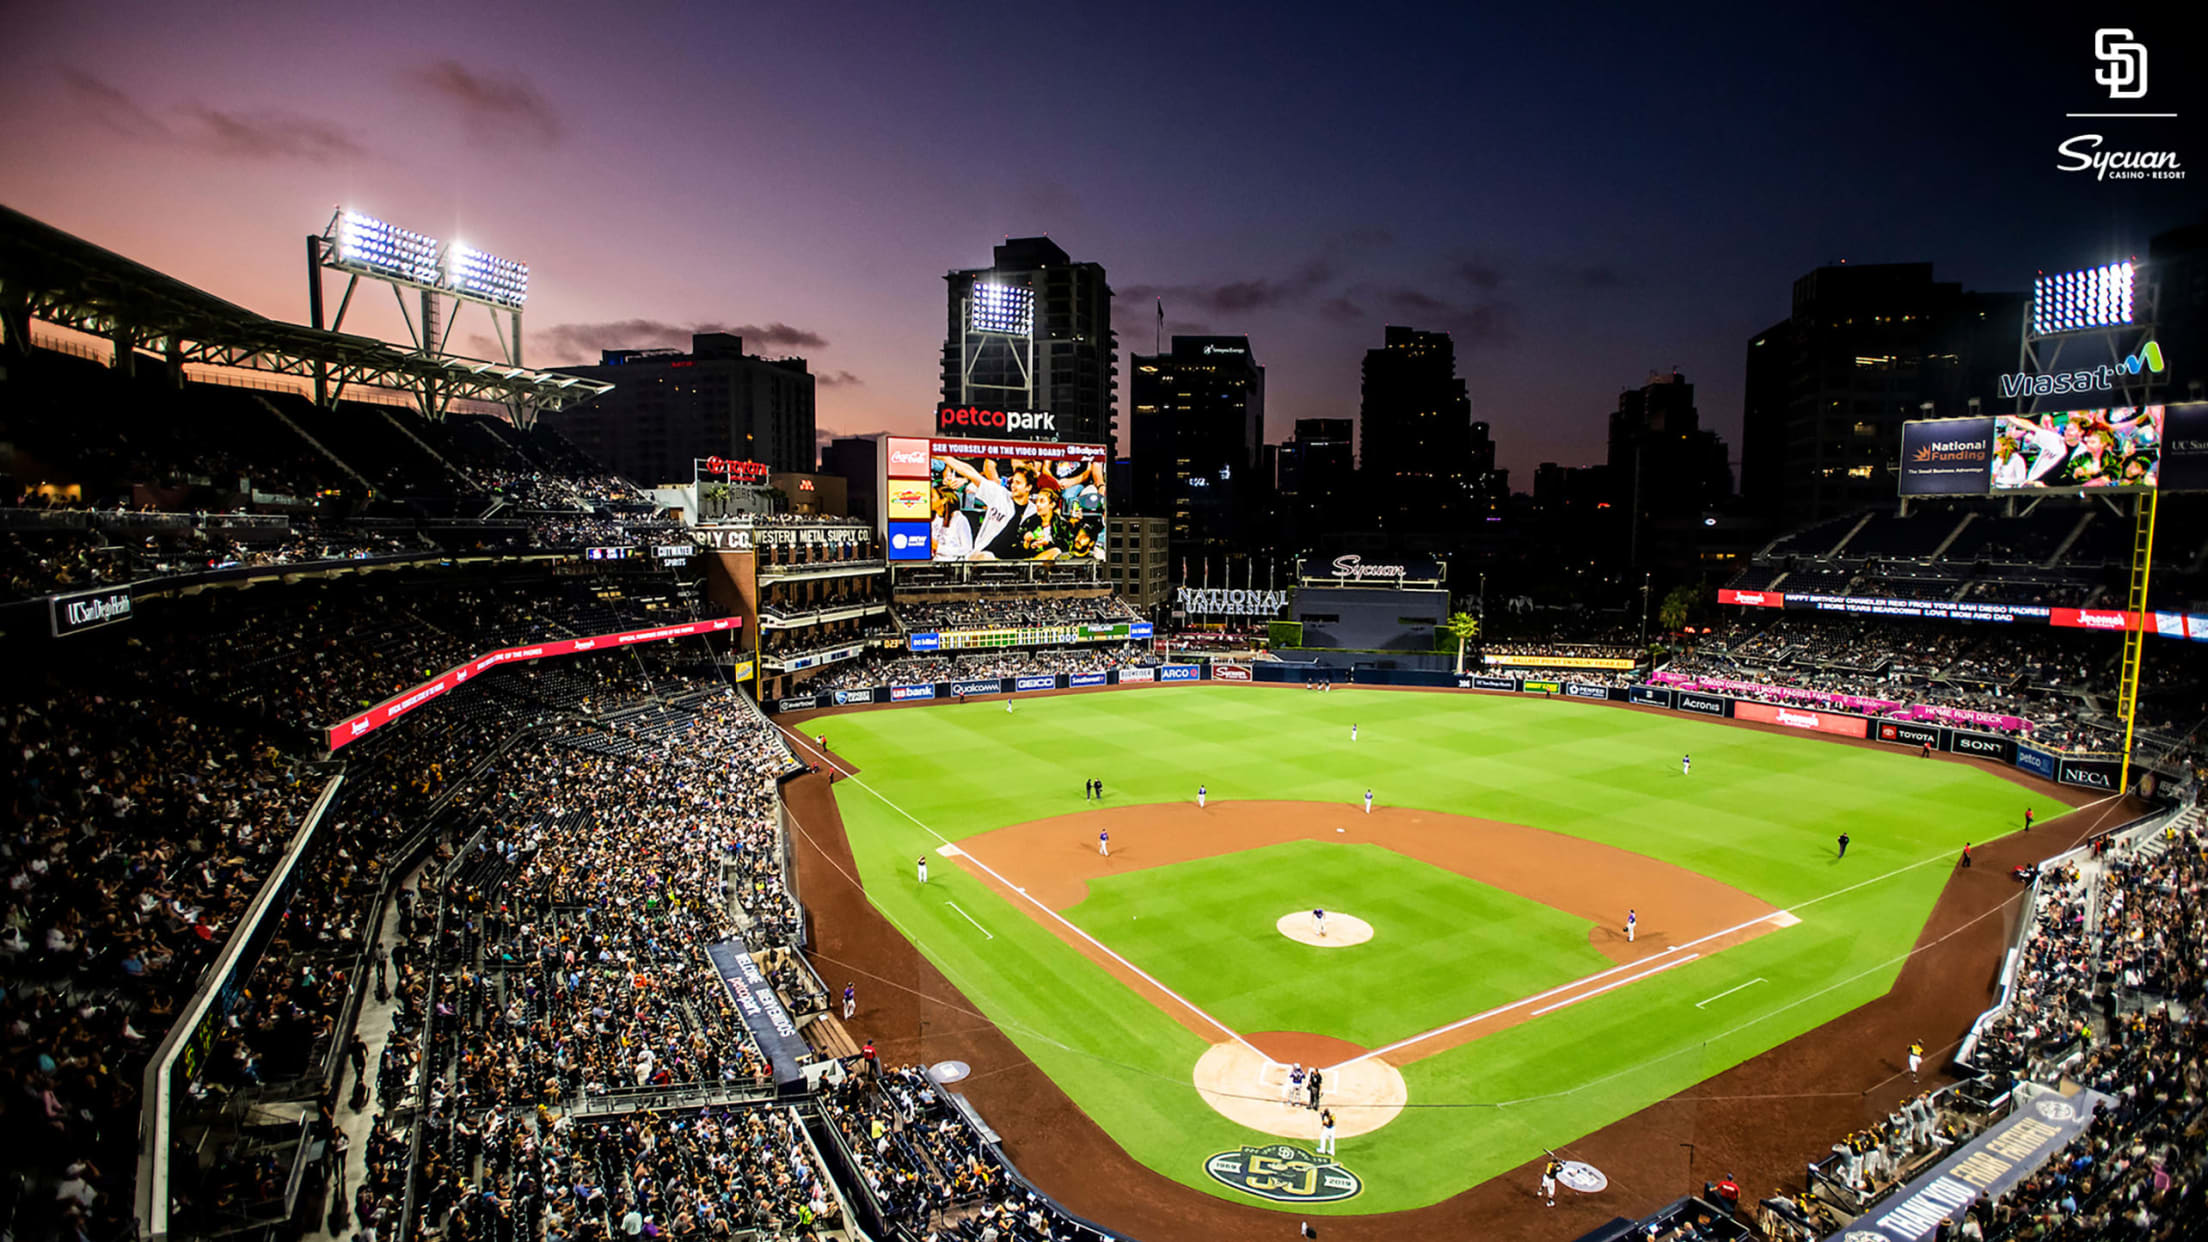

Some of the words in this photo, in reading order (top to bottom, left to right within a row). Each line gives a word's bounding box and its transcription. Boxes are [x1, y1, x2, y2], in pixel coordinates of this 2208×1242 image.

[2001, 365, 2114, 398] Viasat
[932, 443, 947, 452] SEE
[949, 444, 985, 454] YOURSELF
[1016, 447, 1037, 456] VIDEO
[1932, 440, 1986, 452] National
[1932, 450, 1986, 461] Funding
[725, 459, 768, 476] TOYOTA
[754, 530, 797, 544] WESTERN
[800, 530, 827, 544] METAL
[827, 529, 856, 543] SUPPLY
[1332, 554, 1406, 580] Sycuan
[1176, 587, 1289, 605] NATIONAL
[1185, 602, 1280, 616] UNIVERSITY
[1162, 669, 1188, 678] ARCO
[952, 683, 1000, 695] Qualcomm
[1018, 677, 1054, 689] GEICO
[1683, 698, 1721, 712] Acronis
[1925, 707, 1951, 717] HOME
[1954, 711, 1974, 720] RUN
[1976, 713, 2003, 723] DECK
[1899, 729, 1935, 743] TOYOTA
[2019, 752, 2041, 768] petco
[2065, 768, 2111, 787] NECA
[1329, 1178, 1351, 1187] 2019
